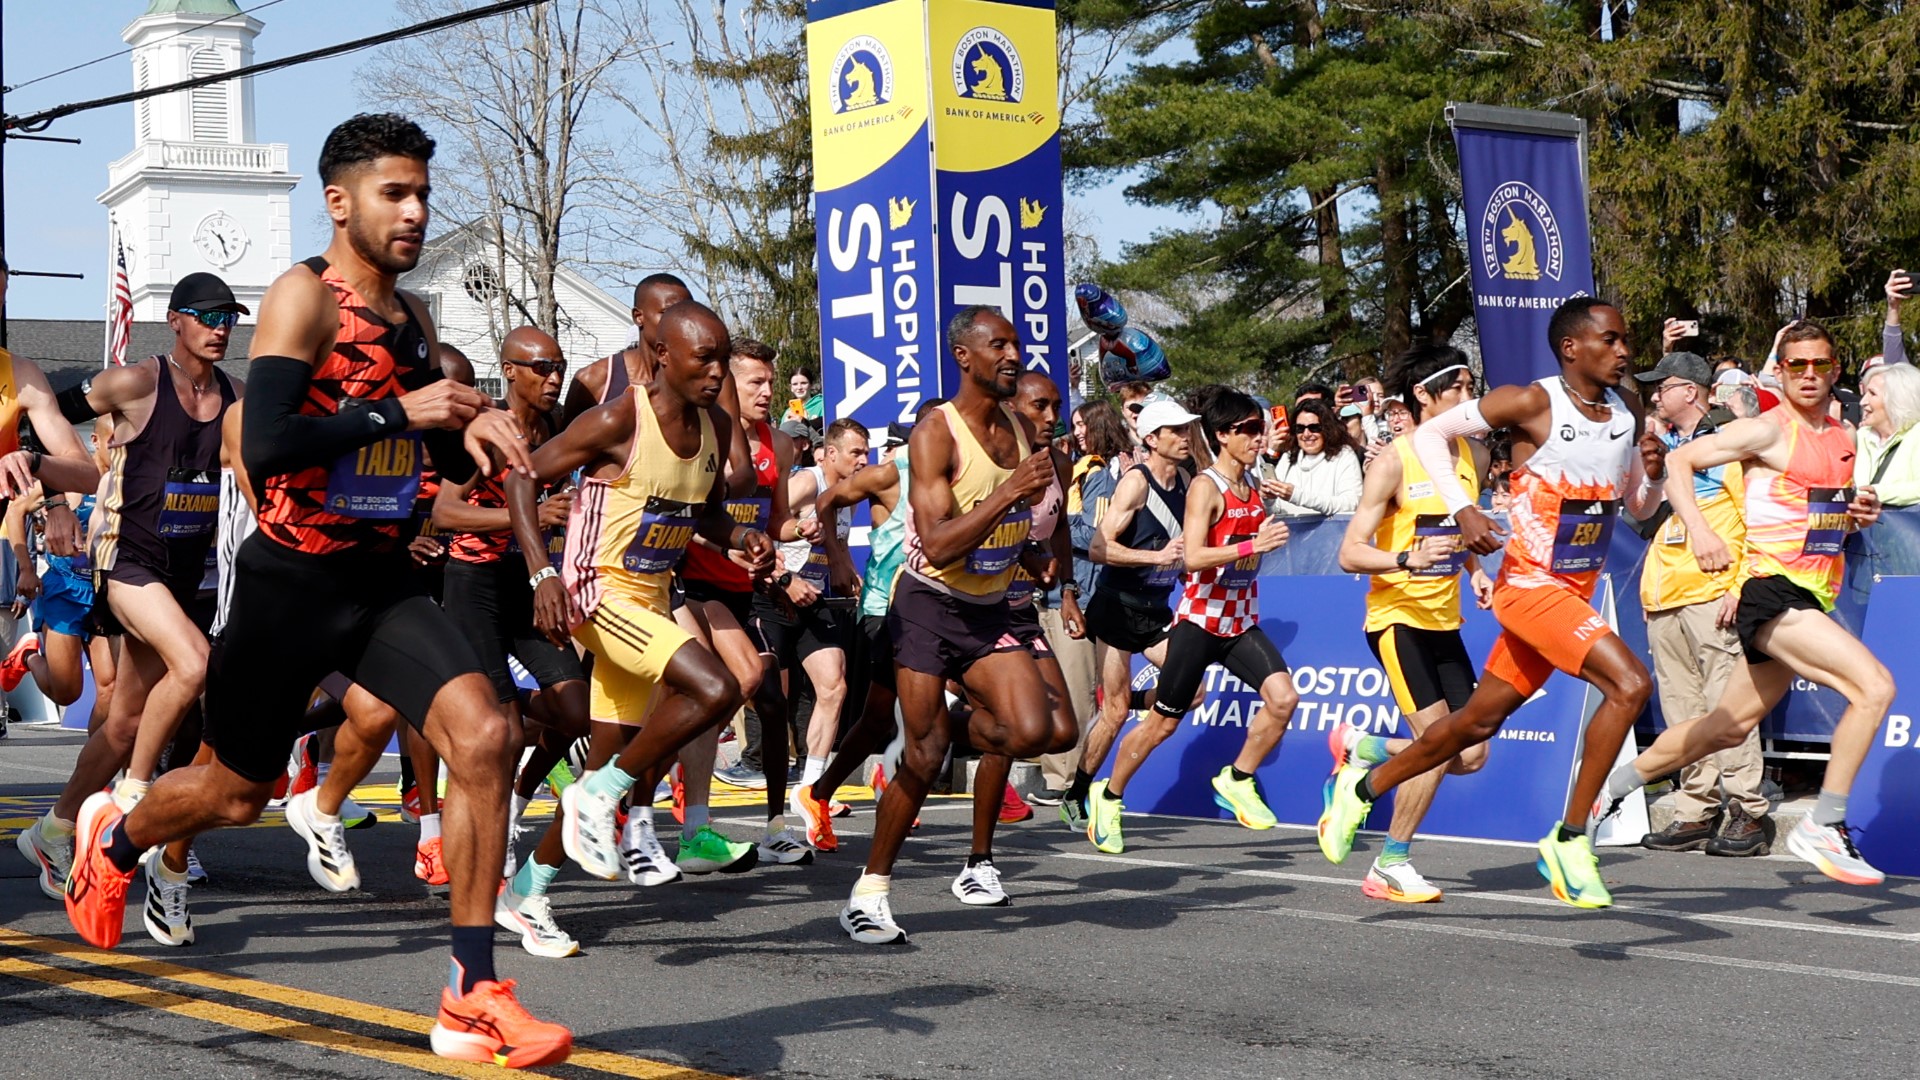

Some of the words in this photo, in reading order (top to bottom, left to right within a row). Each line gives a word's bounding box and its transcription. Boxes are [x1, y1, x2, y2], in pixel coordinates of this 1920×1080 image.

[958, 30, 988, 57] BOSTON
[834, 39, 861, 74] BOSTON
[865, 39, 891, 94] MARATHON
[955, 63, 963, 88] THE
[993, 33, 1022, 95] MARATHON
[823, 125, 845, 137] BANK
[846, 122, 857, 132] OF
[858, 113, 896, 130] AMERICA
[945, 107, 971, 117] BANK
[972, 110, 984, 119] OF
[985, 111, 1027, 124] AMERICA
[1487, 186, 1519, 224] BOSTON
[1524, 189, 1561, 272] MARATHON
[1477, 294, 1503, 308] BANK
[1504, 296, 1517, 308] OF
[351, 503, 400, 512] MARATHON
[1288, 665, 1391, 698] OSTO
[1191, 699, 1400, 735] MATHON
[1499, 729, 1556, 743] AMERICA
[1884, 714, 1920, 749] B
